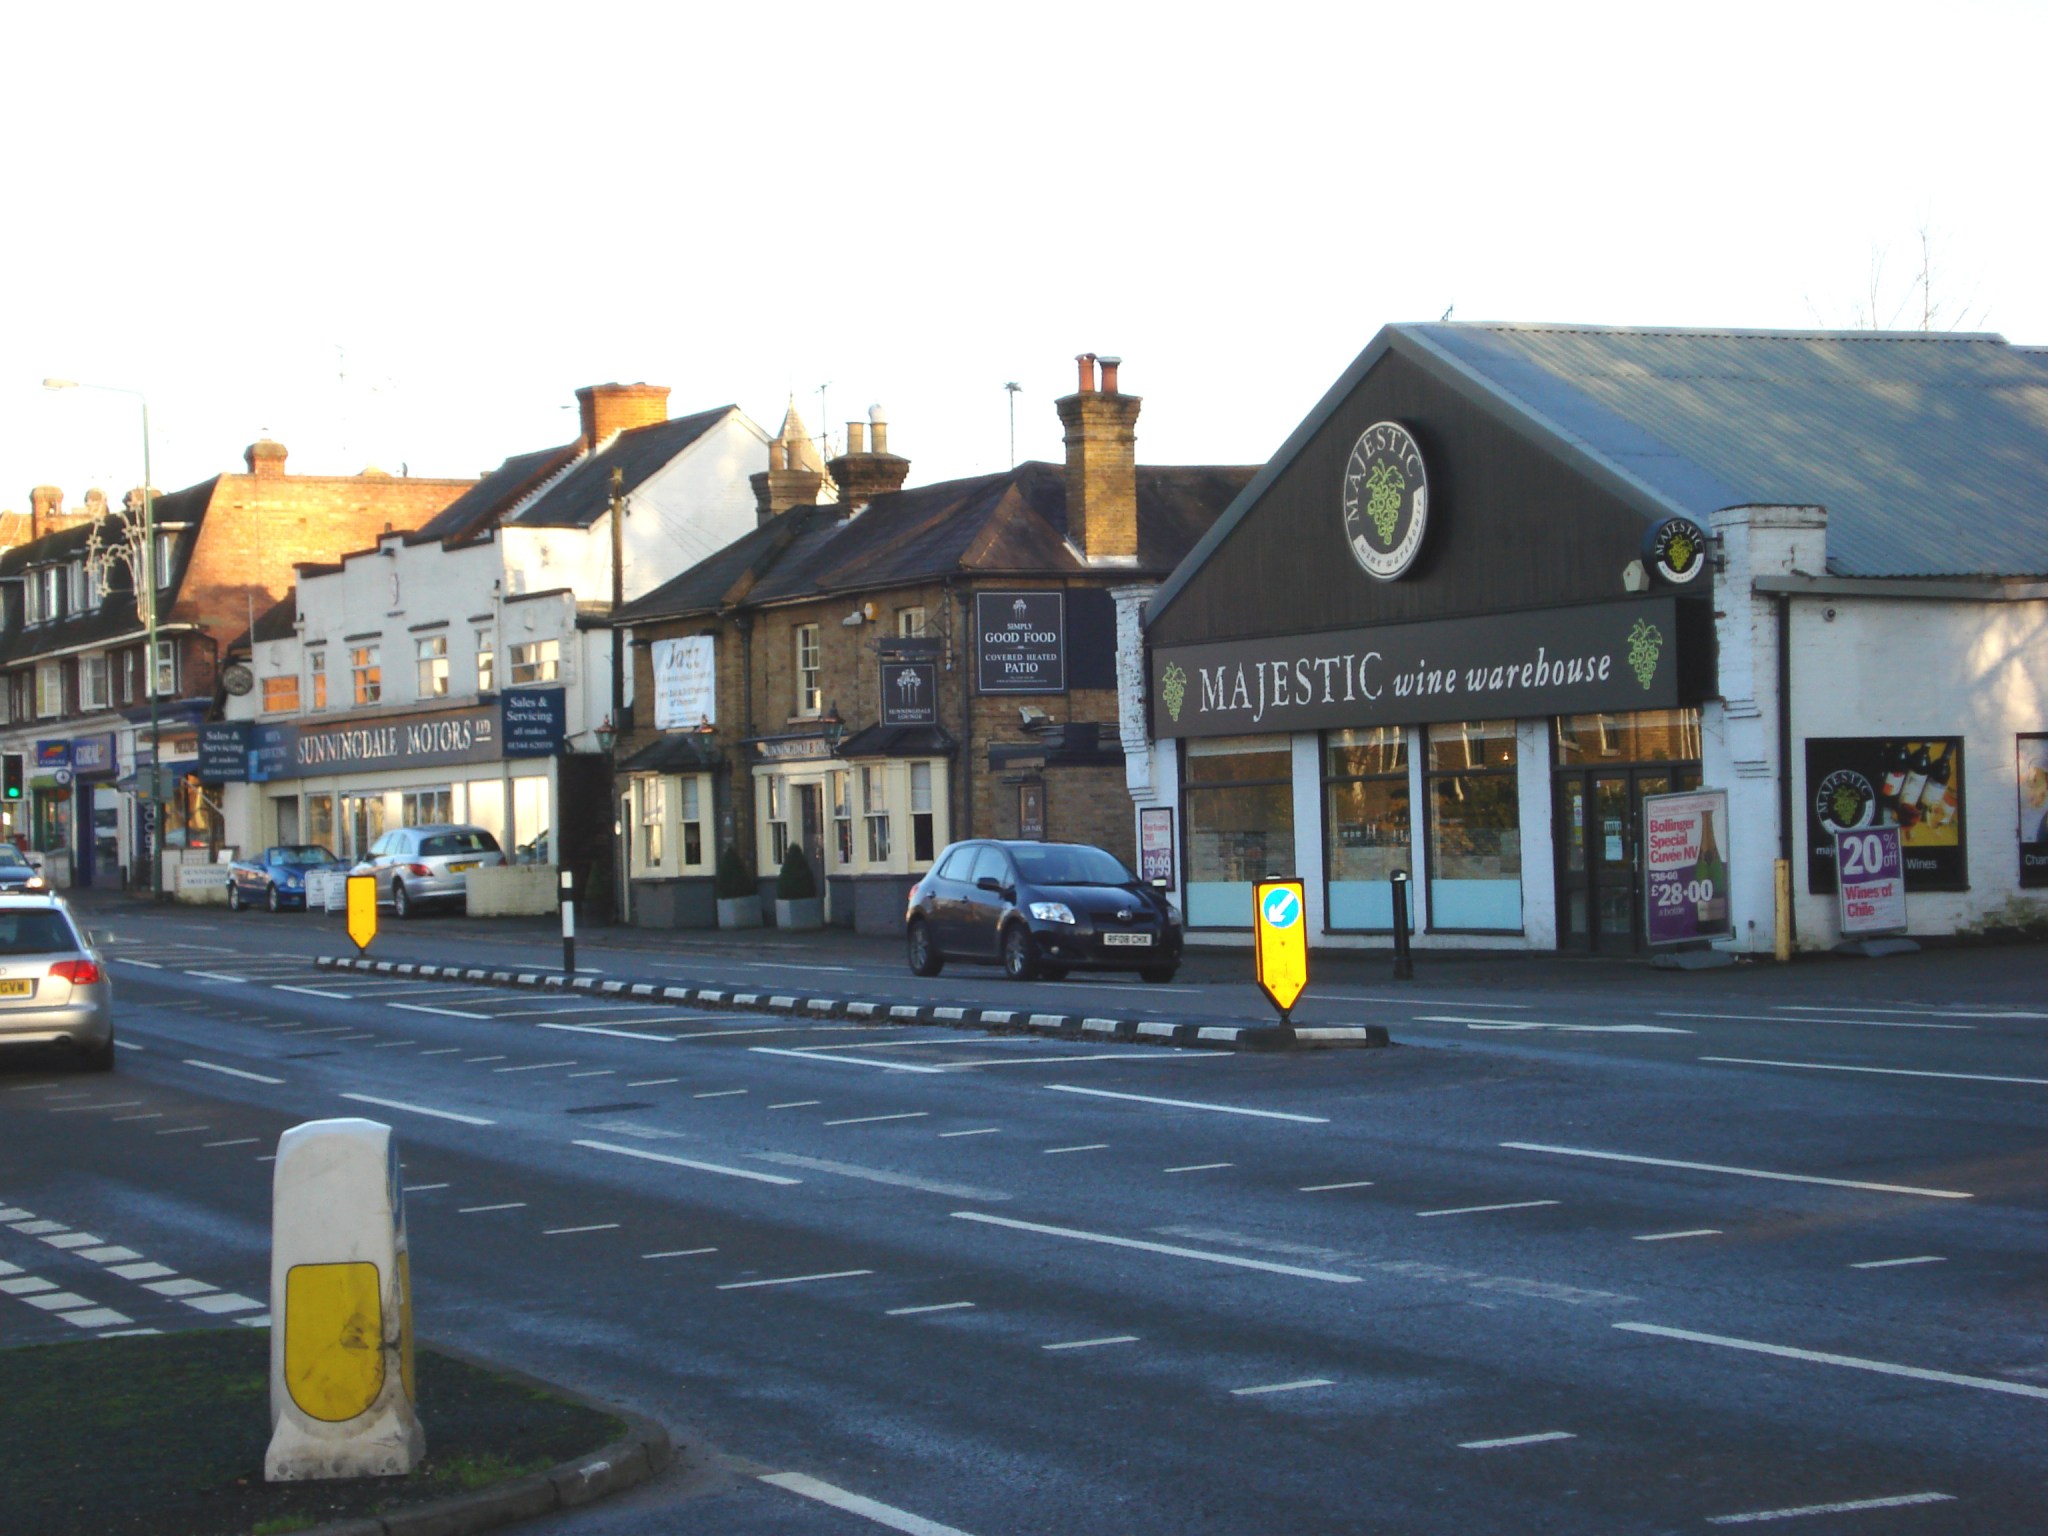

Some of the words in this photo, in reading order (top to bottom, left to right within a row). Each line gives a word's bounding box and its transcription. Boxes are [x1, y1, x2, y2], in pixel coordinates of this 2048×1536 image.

[1346, 427, 1420, 522] MAJESTIC
[1656, 522, 1701, 555] MAJESTIC
[985, 632, 1020, 643] GOOD
[1024, 632, 1056, 643] FOOD
[985, 653, 1023, 661] COVERED
[1026, 653, 1057, 661] HEATED
[1005, 662, 1039, 673] PATIO
[1199, 651, 1384, 723] MAJESTIC
[1393, 659, 1456, 697] wine
[1465, 647, 1611, 693] warehouse
[510, 696, 536, 707] Sales
[538, 696, 547, 707] &
[506, 710, 553, 723] Servicing
[206, 730, 230, 740] Sales
[297, 727, 398, 764] SUNNINGDALE
[406, 719, 471, 755] MOTORS
[203, 742, 244, 755] Servicing
[1819, 772, 1868, 813] MAJESTIC
[1650, 818, 1695, 833] Bollinger
[1650, 833, 1688, 849] Special
[1683, 846, 1698, 859] NV
[1884, 852, 1897, 867] off
[1906, 858, 1937, 870] Wines
[1845, 885, 1879, 900] Wines
[1881, 883, 1893, 897] of
[1847, 903, 1875, 917] Chile
